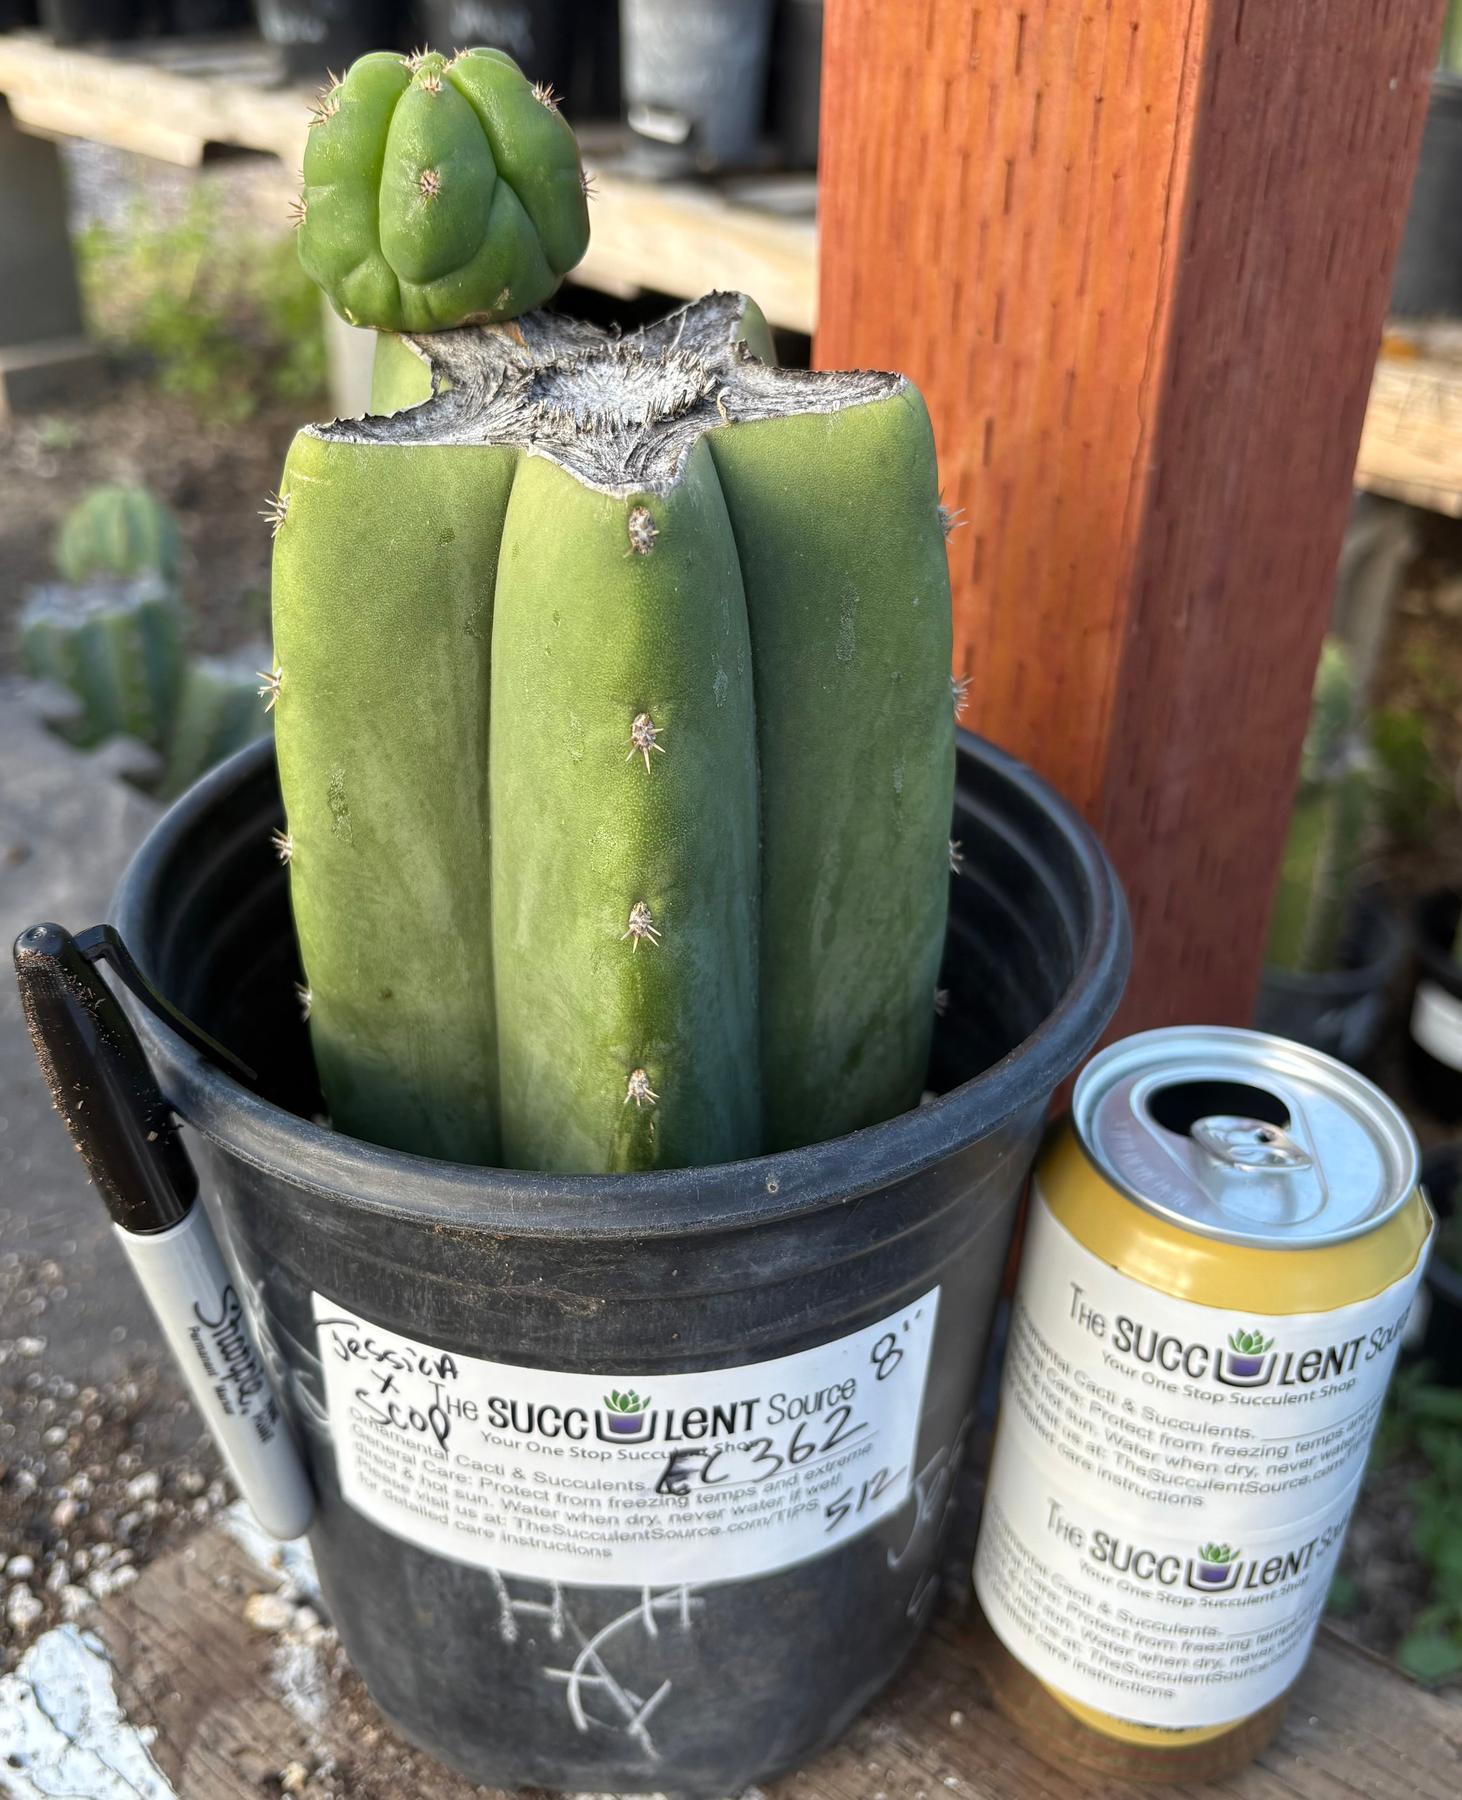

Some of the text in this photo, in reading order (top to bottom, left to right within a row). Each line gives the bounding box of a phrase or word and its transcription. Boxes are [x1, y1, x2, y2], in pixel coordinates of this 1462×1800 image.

[766, 1378, 857, 1426] Source
[1074, 1369, 1116, 1404] Cacti
[1121, 1397, 1135, 1414] &
[1102, 1349, 1357, 1407] Your One Stop Succulent Shop
[480, 1430, 522, 1450] Your
[526, 1440, 565, 1457] One
[569, 1445, 613, 1462] Stop
[1088, 1399, 1155, 1441] Protect
[1159, 1432, 1203, 1453] from
[1210, 1441, 1289, 1459] freezing
[1295, 1426, 1344, 1454] temps
[1104, 1427, 1161, 1462] Water
[1164, 1454, 1217, 1473] when
[1265, 1454, 1315, 1475] never
[352, 1423, 873, 1510] General Care: Protect from freezing temps and extreme
[354, 1441, 397, 1472] direct
[403, 1466, 415, 1480] &
[420, 1473, 448, 1495] hot
[500, 1498, 560, 1519] Water
[567, 1511, 619, 1525] when
[668, 1507, 726, 1523] never
[731, 1496, 786, 1516] water
[790, 1486, 802, 1504] if
[456, 1453, 505, 1476] Cacti
[512, 1466, 526, 1480] &
[1097, 1462, 1205, 1507] instructions
[383, 1487, 449, 1525] detailed
[454, 1518, 496, 1539] care
[501, 1531, 613, 1559] instructions
[416, 1488, 448, 1510] visit
[455, 1503, 479, 1519] us
